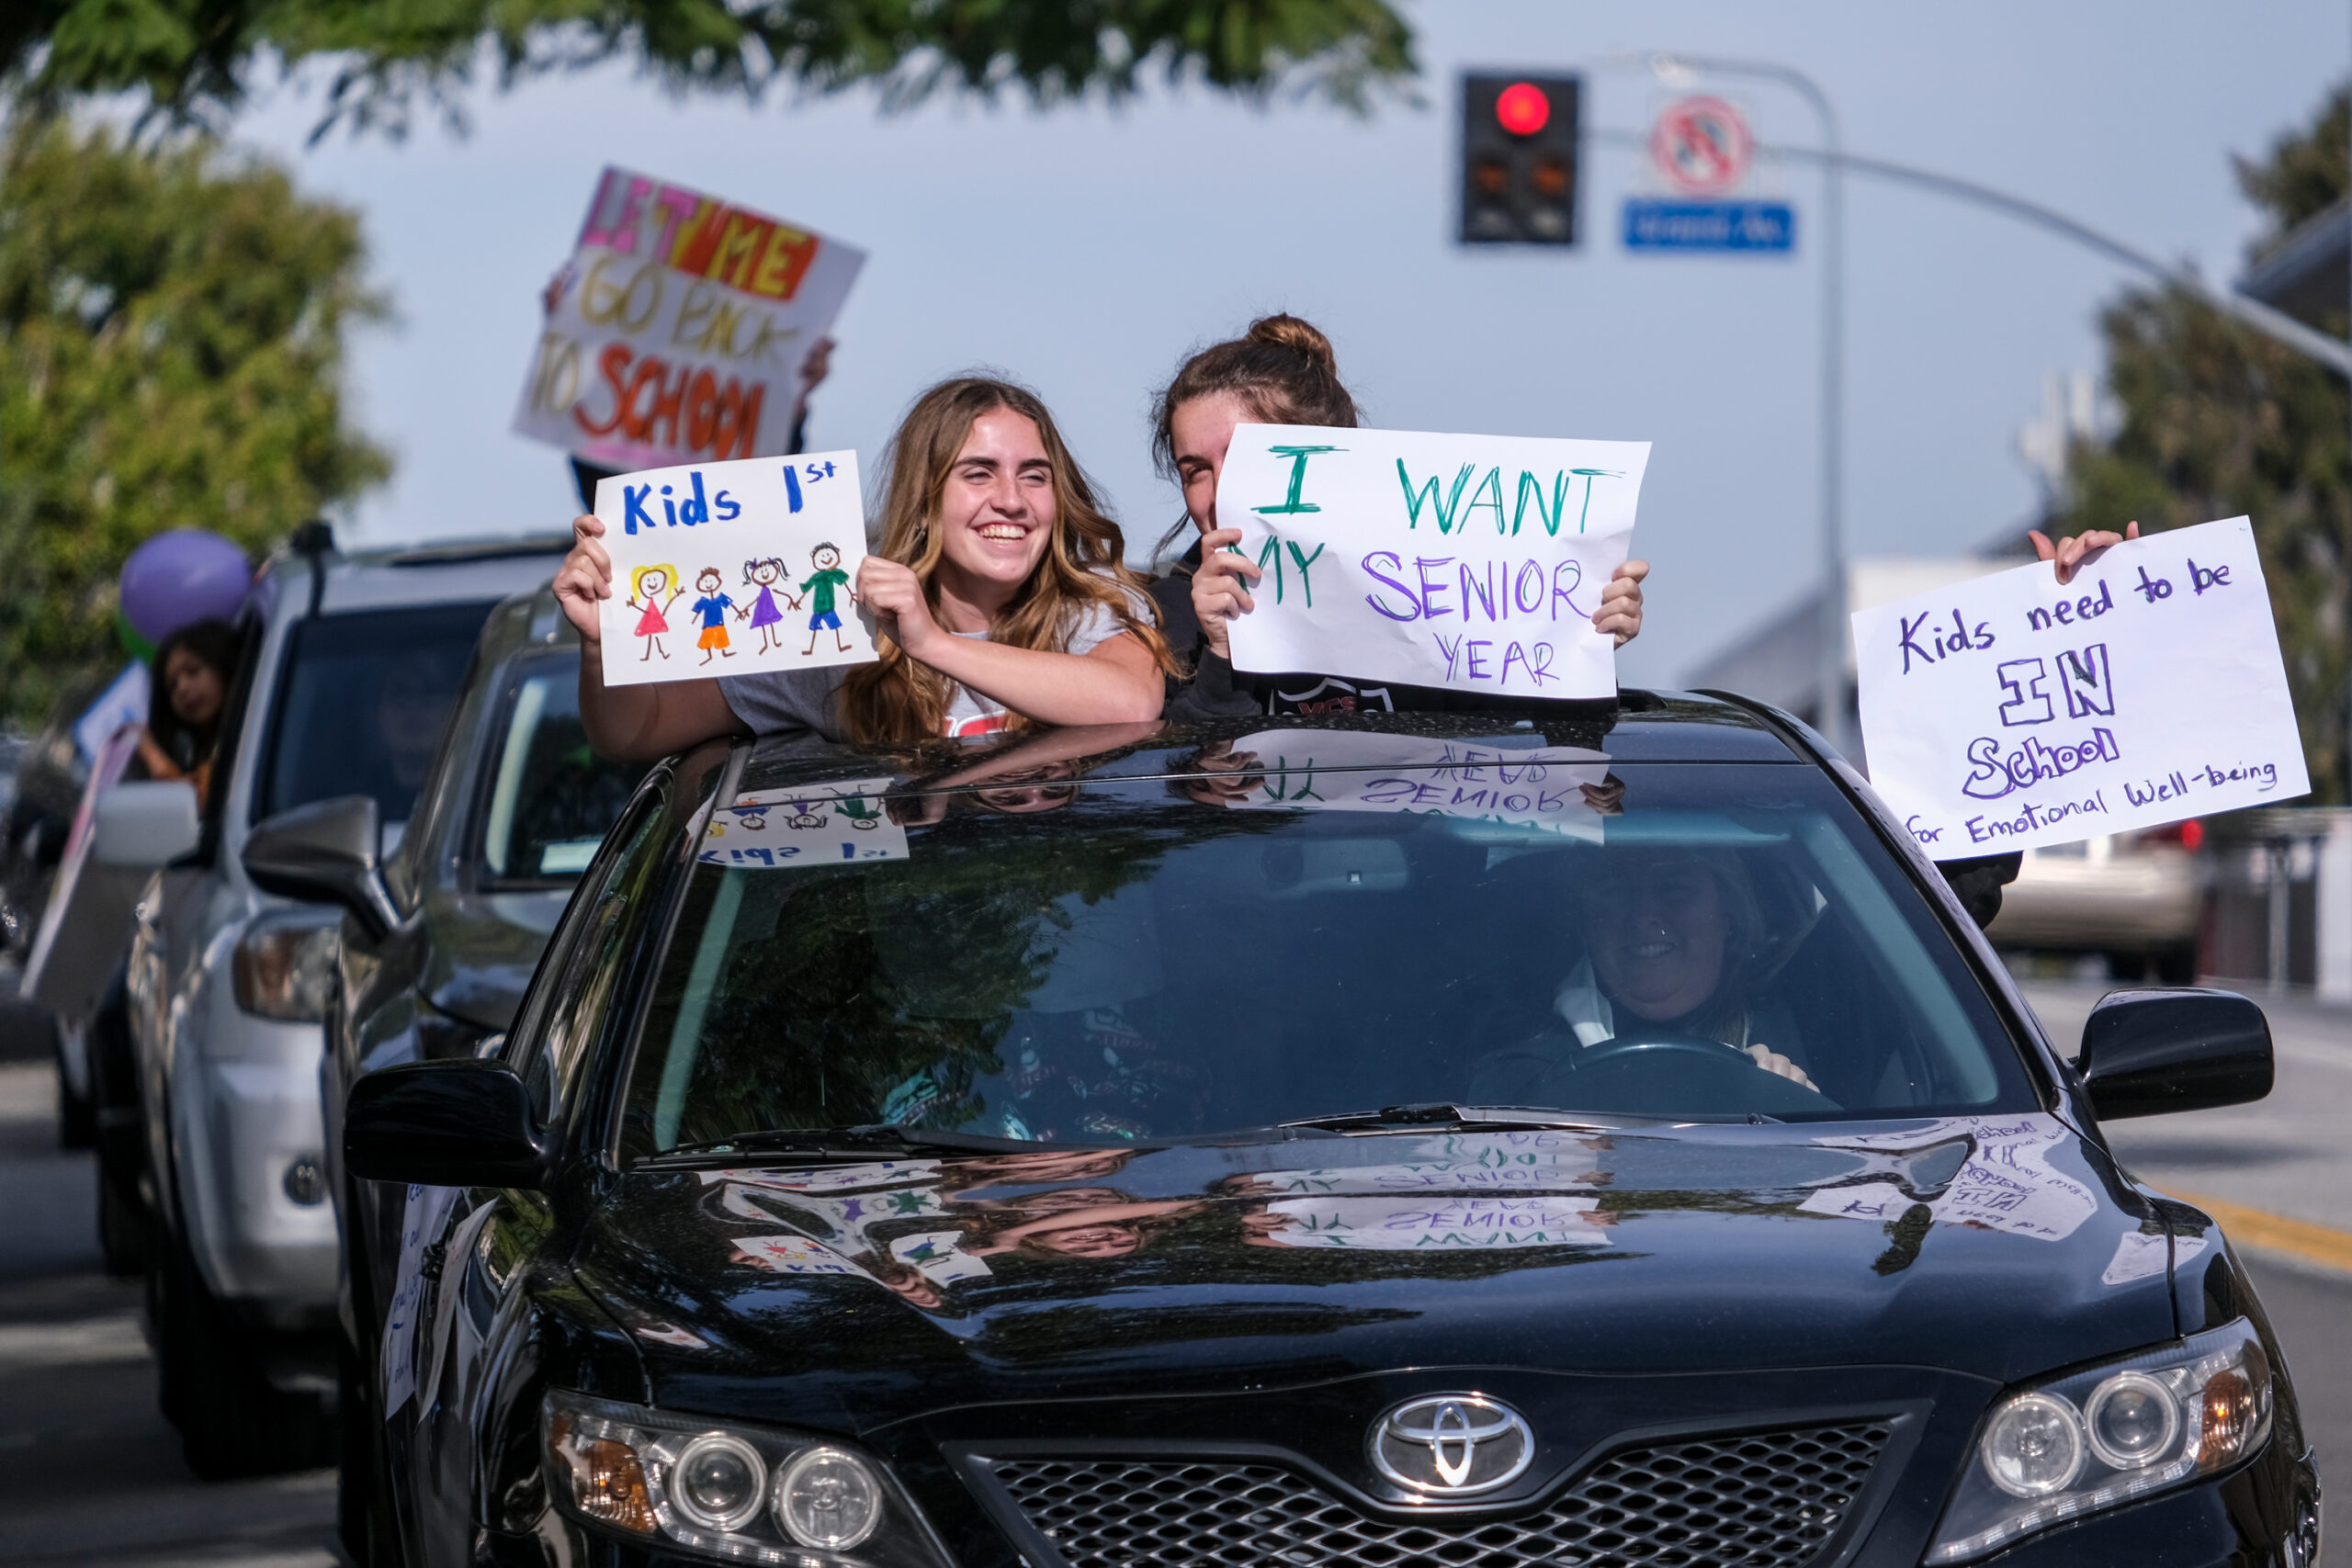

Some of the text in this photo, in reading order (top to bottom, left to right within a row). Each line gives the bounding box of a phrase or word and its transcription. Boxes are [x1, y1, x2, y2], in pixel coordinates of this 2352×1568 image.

[705, 210, 808, 298] ME
[581, 254, 799, 364] GO BACK
[531, 332, 764, 460] TO SCHOOL
[624, 471, 741, 535] Kids
[1250, 445, 1627, 537] I WANT
[1362, 551, 1592, 622] SENIOR
[1899, 558, 2233, 675] Kids need to be
[1433, 633, 1561, 687] YEAR
[1996, 643, 2116, 728] IN
[1905, 760, 2278, 844] for Emotional Well-being
[1962, 728, 2120, 800] School
